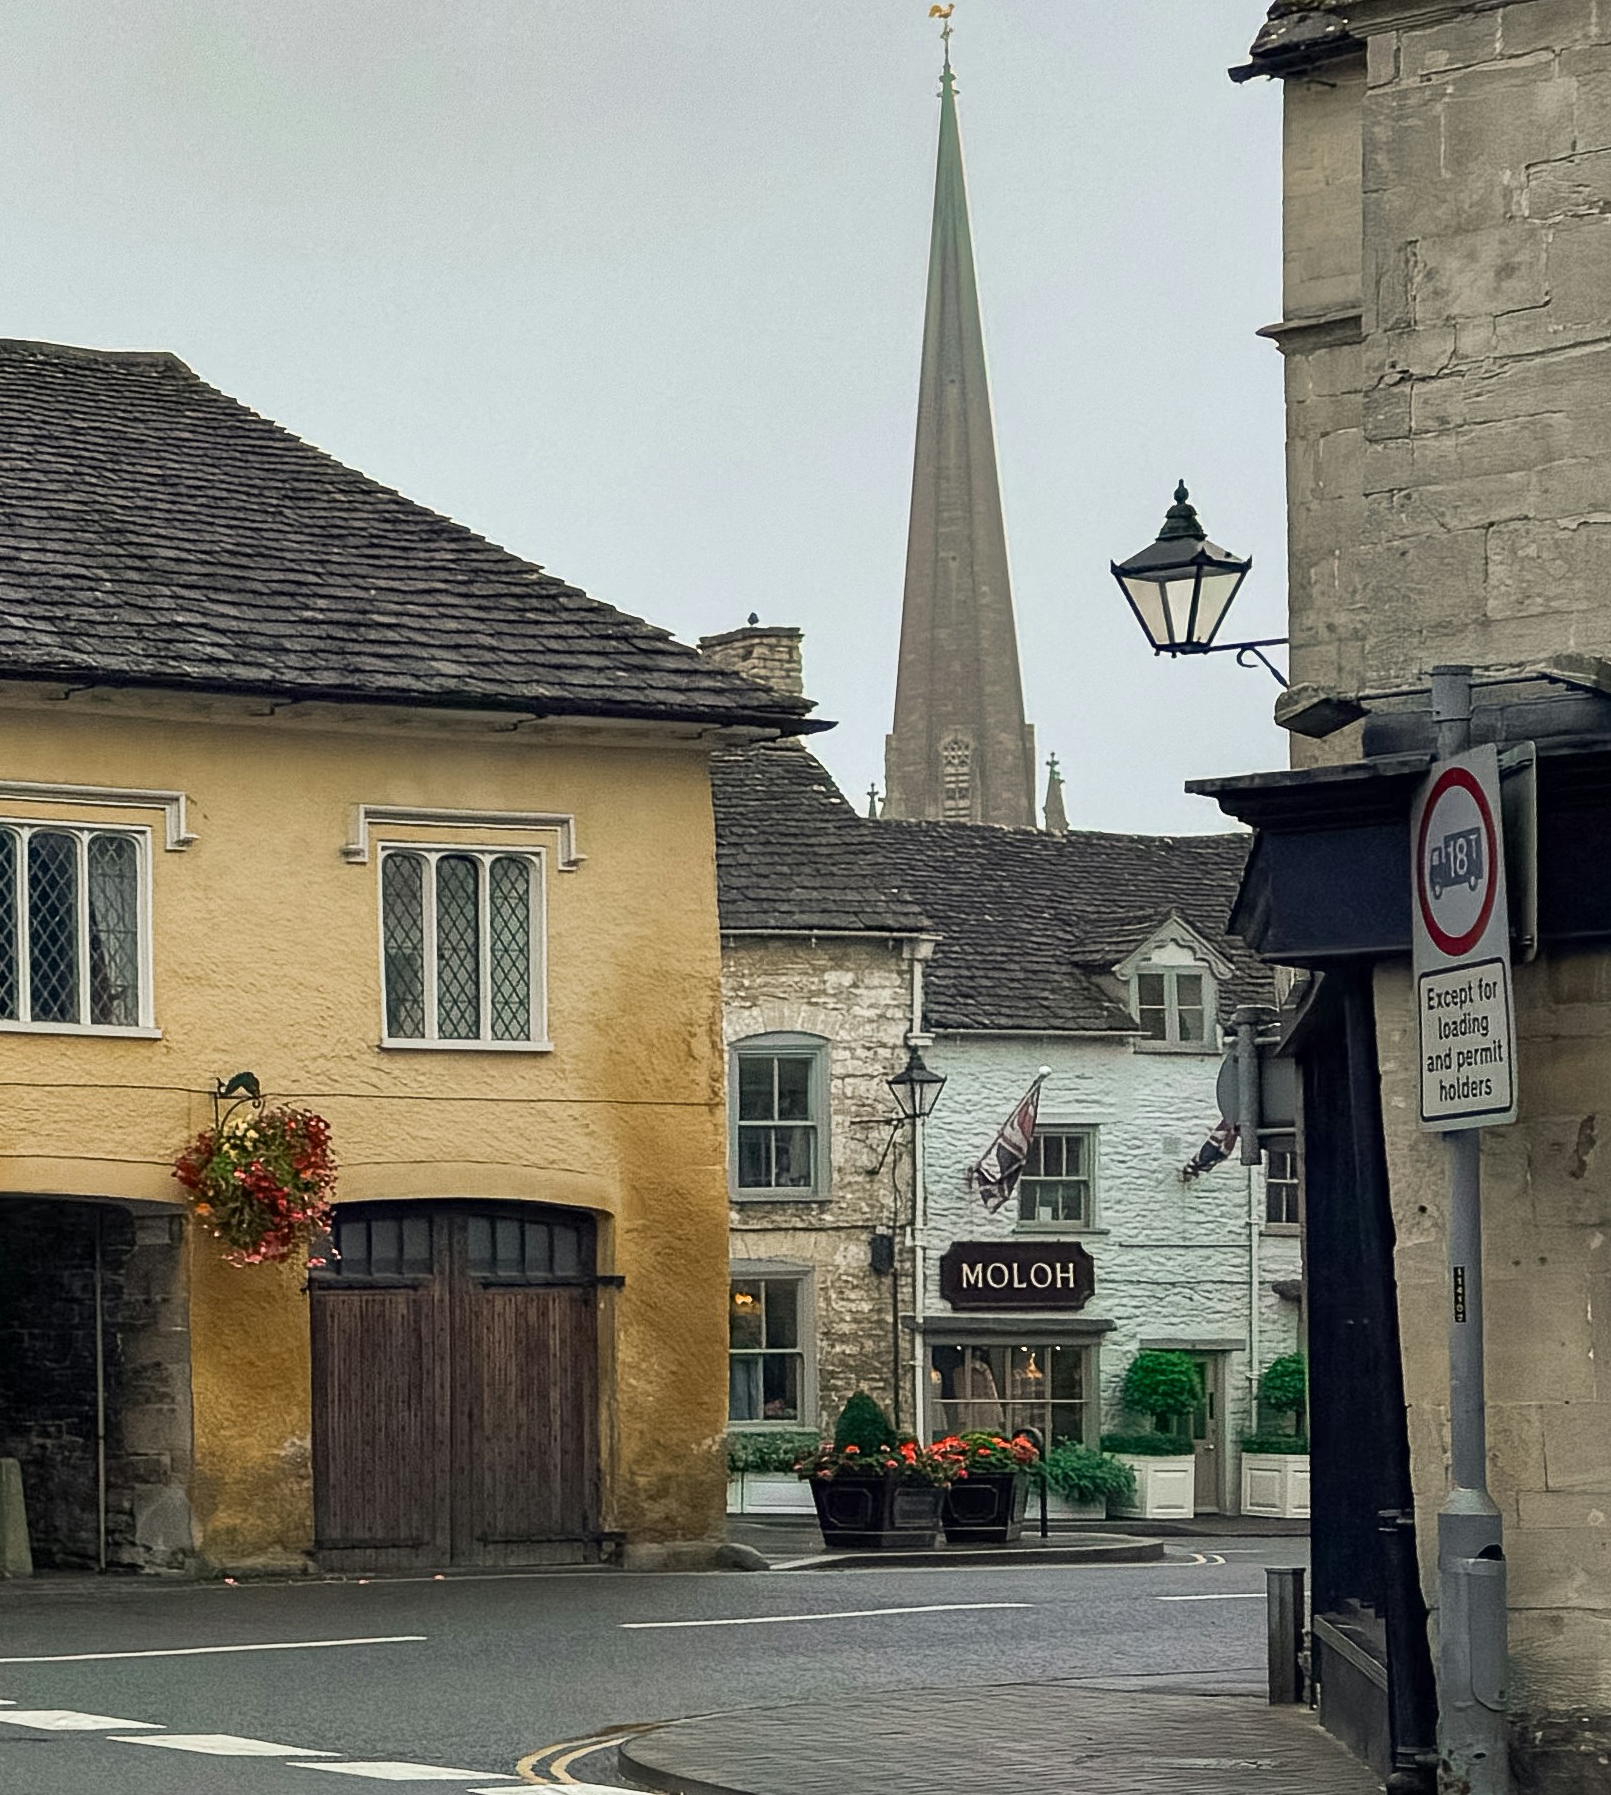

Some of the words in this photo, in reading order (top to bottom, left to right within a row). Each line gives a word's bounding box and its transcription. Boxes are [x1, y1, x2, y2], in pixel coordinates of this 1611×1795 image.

[1426, 980, 1474, 1011] Except
[1477, 976, 1498, 1003] for
[1438, 1011, 1490, 1040] loading
[1426, 1045, 1452, 1073] and
[1456, 1038, 1503, 1073] permit
[1439, 1075, 1493, 1103] holders
[961, 1262, 1075, 1289] MOLOH
